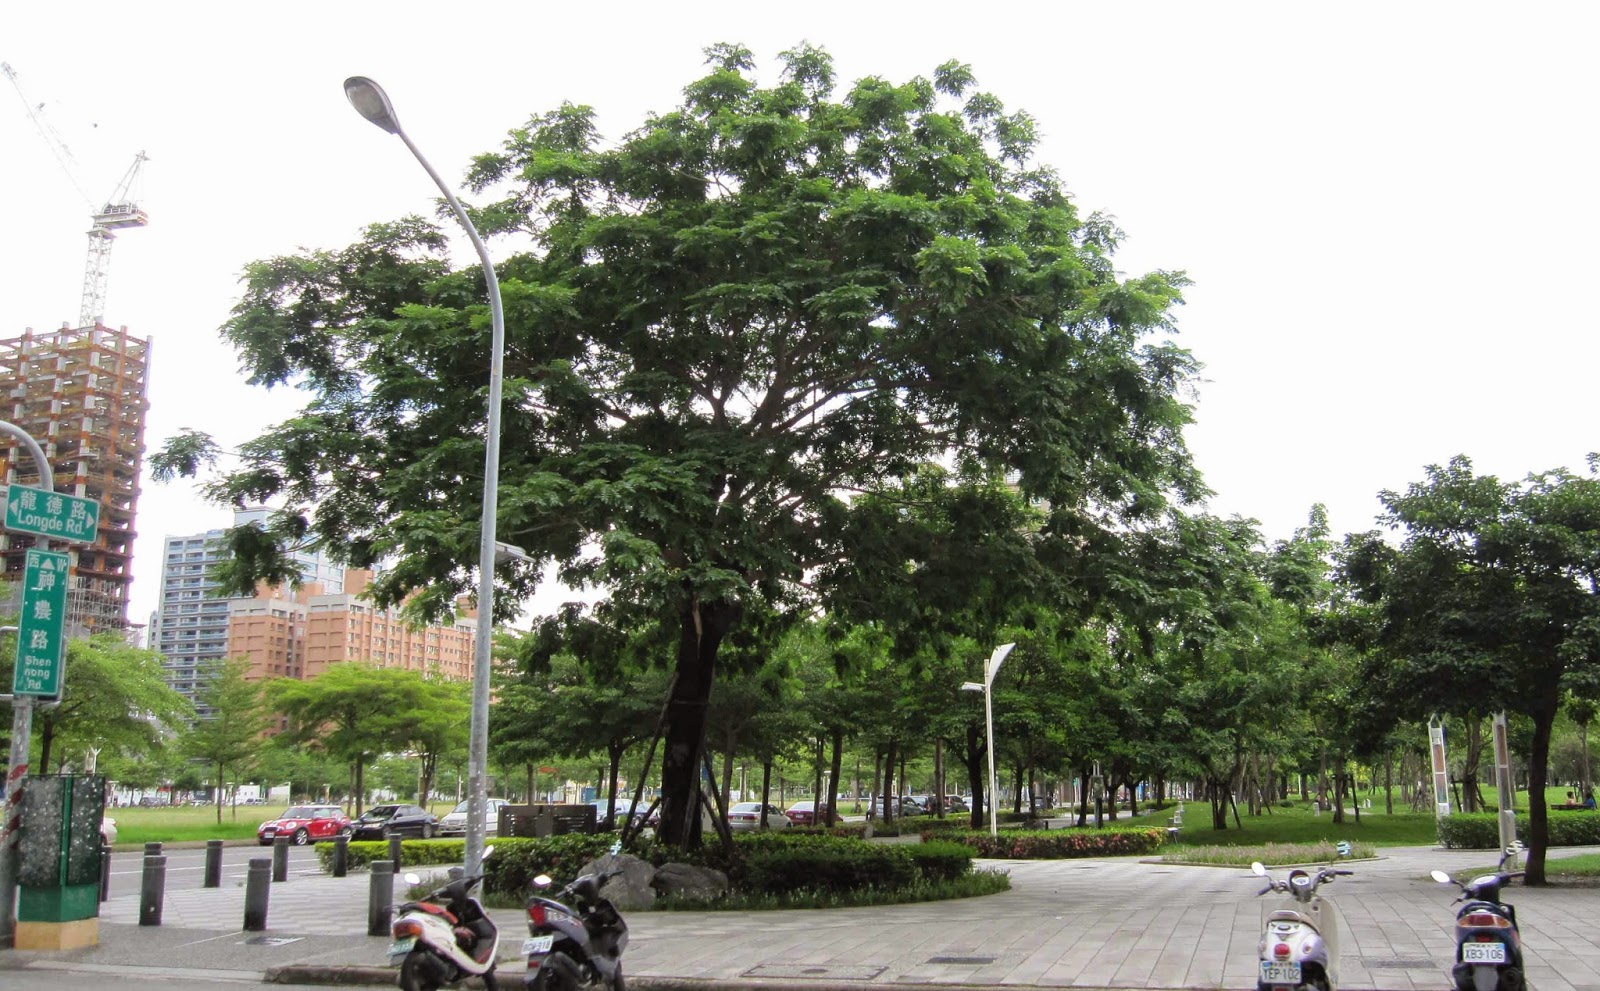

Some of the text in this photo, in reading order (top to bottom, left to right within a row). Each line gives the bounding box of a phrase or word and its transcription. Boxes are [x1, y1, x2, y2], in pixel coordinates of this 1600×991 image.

[20, 490, 87, 520] 龍德路
[17, 509, 85, 535] Longde Rd.
[30, 570, 56, 650] 神農路
[25, 655, 52, 667] Shen
[24, 668, 50, 680] nong
[1464, 949, 1504, 960] XB3-106
[1262, 968, 1299, 980] YEP-102
